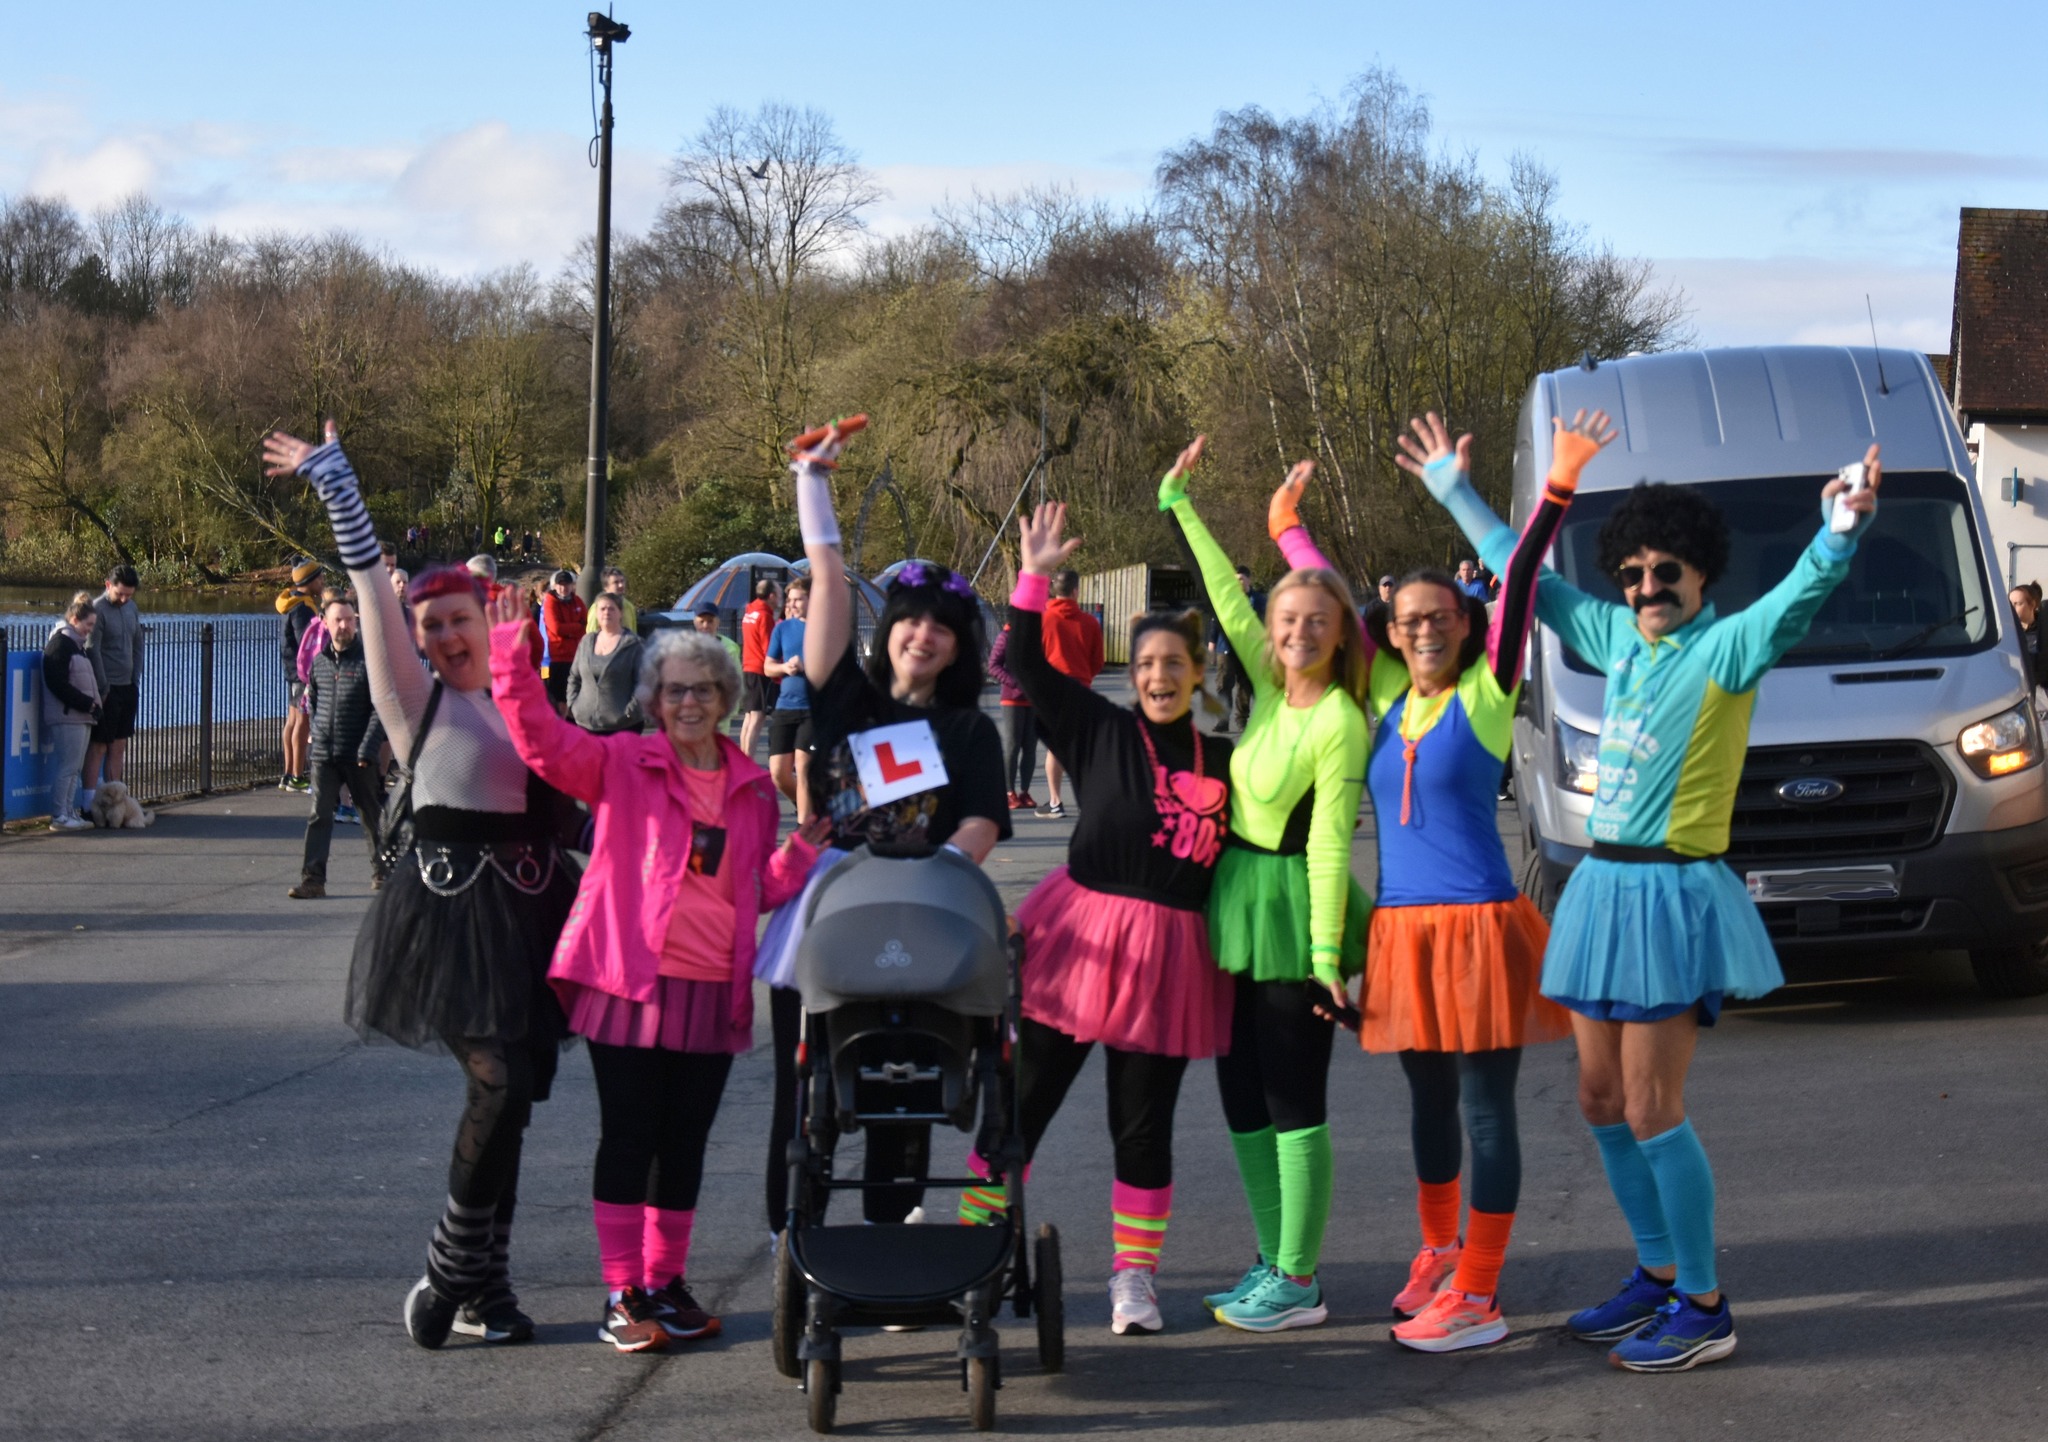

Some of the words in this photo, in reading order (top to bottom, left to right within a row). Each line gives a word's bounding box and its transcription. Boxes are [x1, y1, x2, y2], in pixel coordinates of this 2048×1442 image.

[873, 741, 922, 785] L
[1794, 782, 1828, 797] Ford
[1170, 811, 1222, 869] 80s
